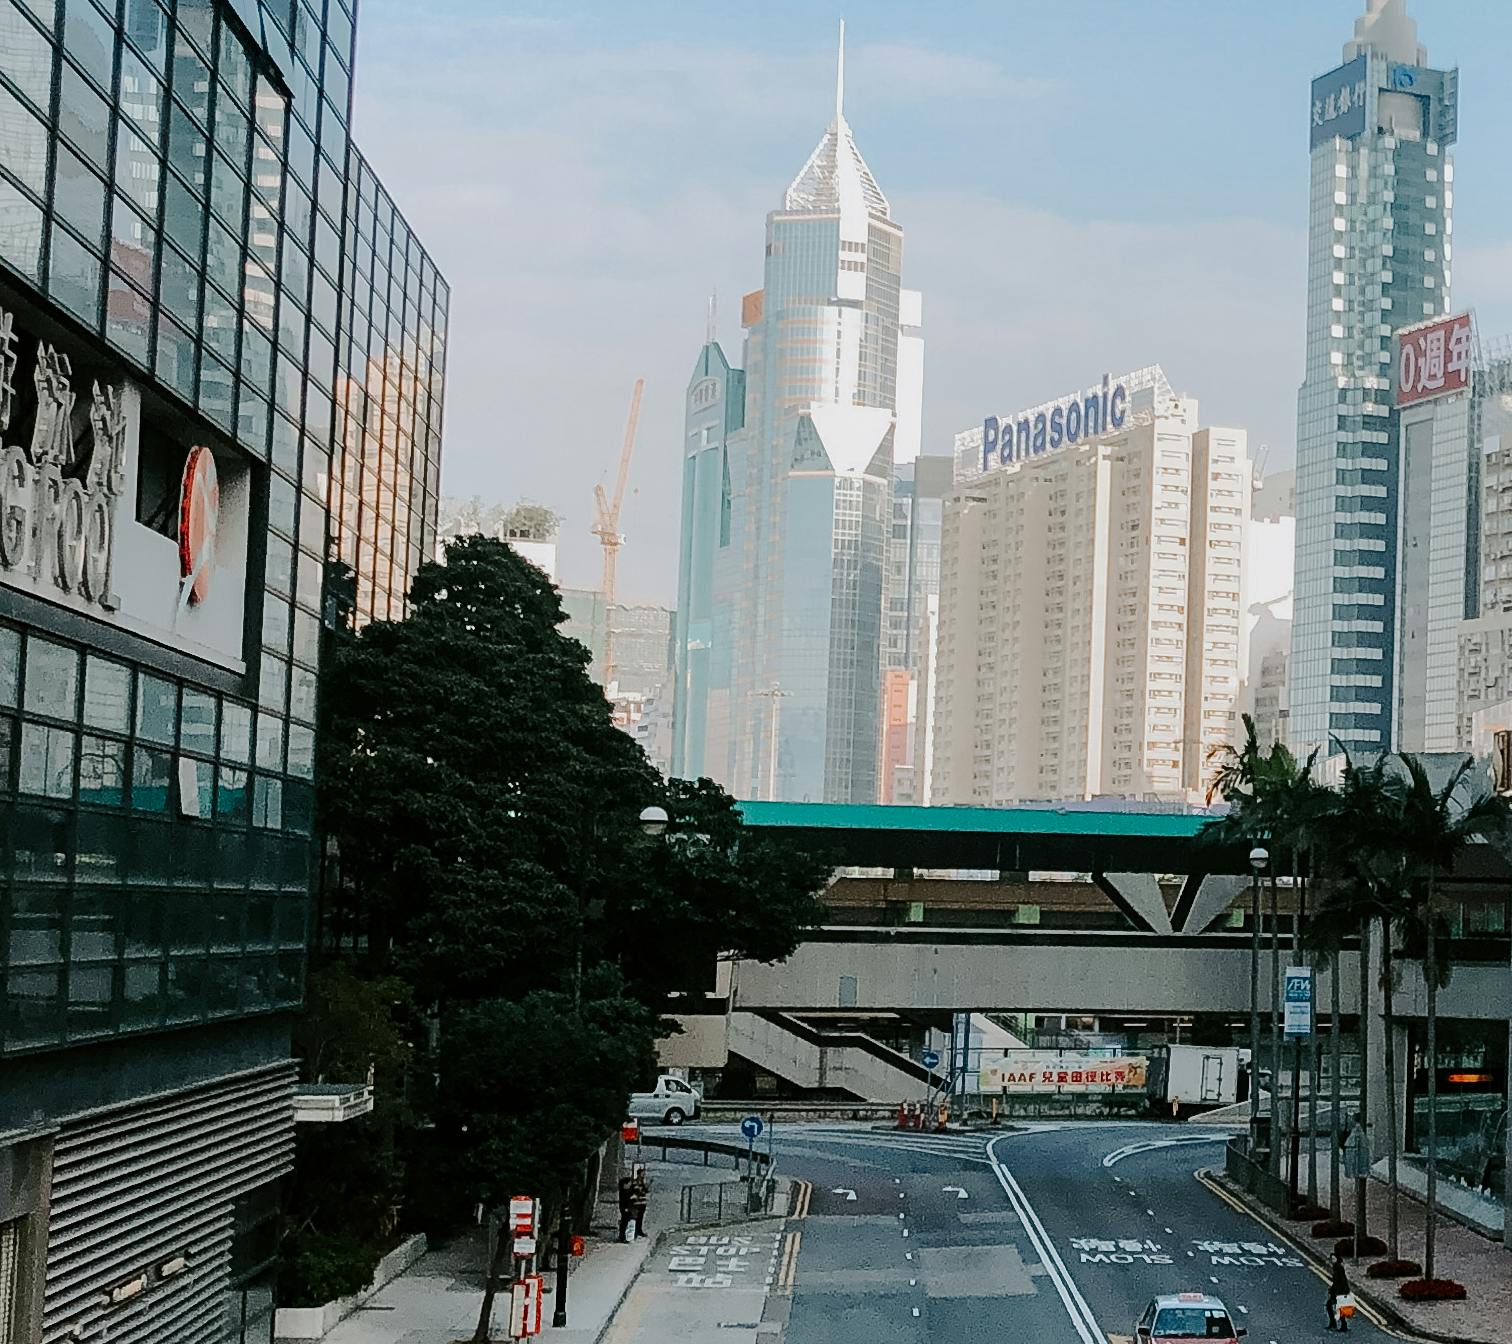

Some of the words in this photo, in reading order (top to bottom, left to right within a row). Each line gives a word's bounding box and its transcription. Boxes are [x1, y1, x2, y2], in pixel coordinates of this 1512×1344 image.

[983, 372, 1126, 471] Panasonic
[1001, 1072, 1037, 1083] IAAF
[1080, 1253, 1174, 1265] SLOW
[1210, 1255, 1304, 1267] SLOW
